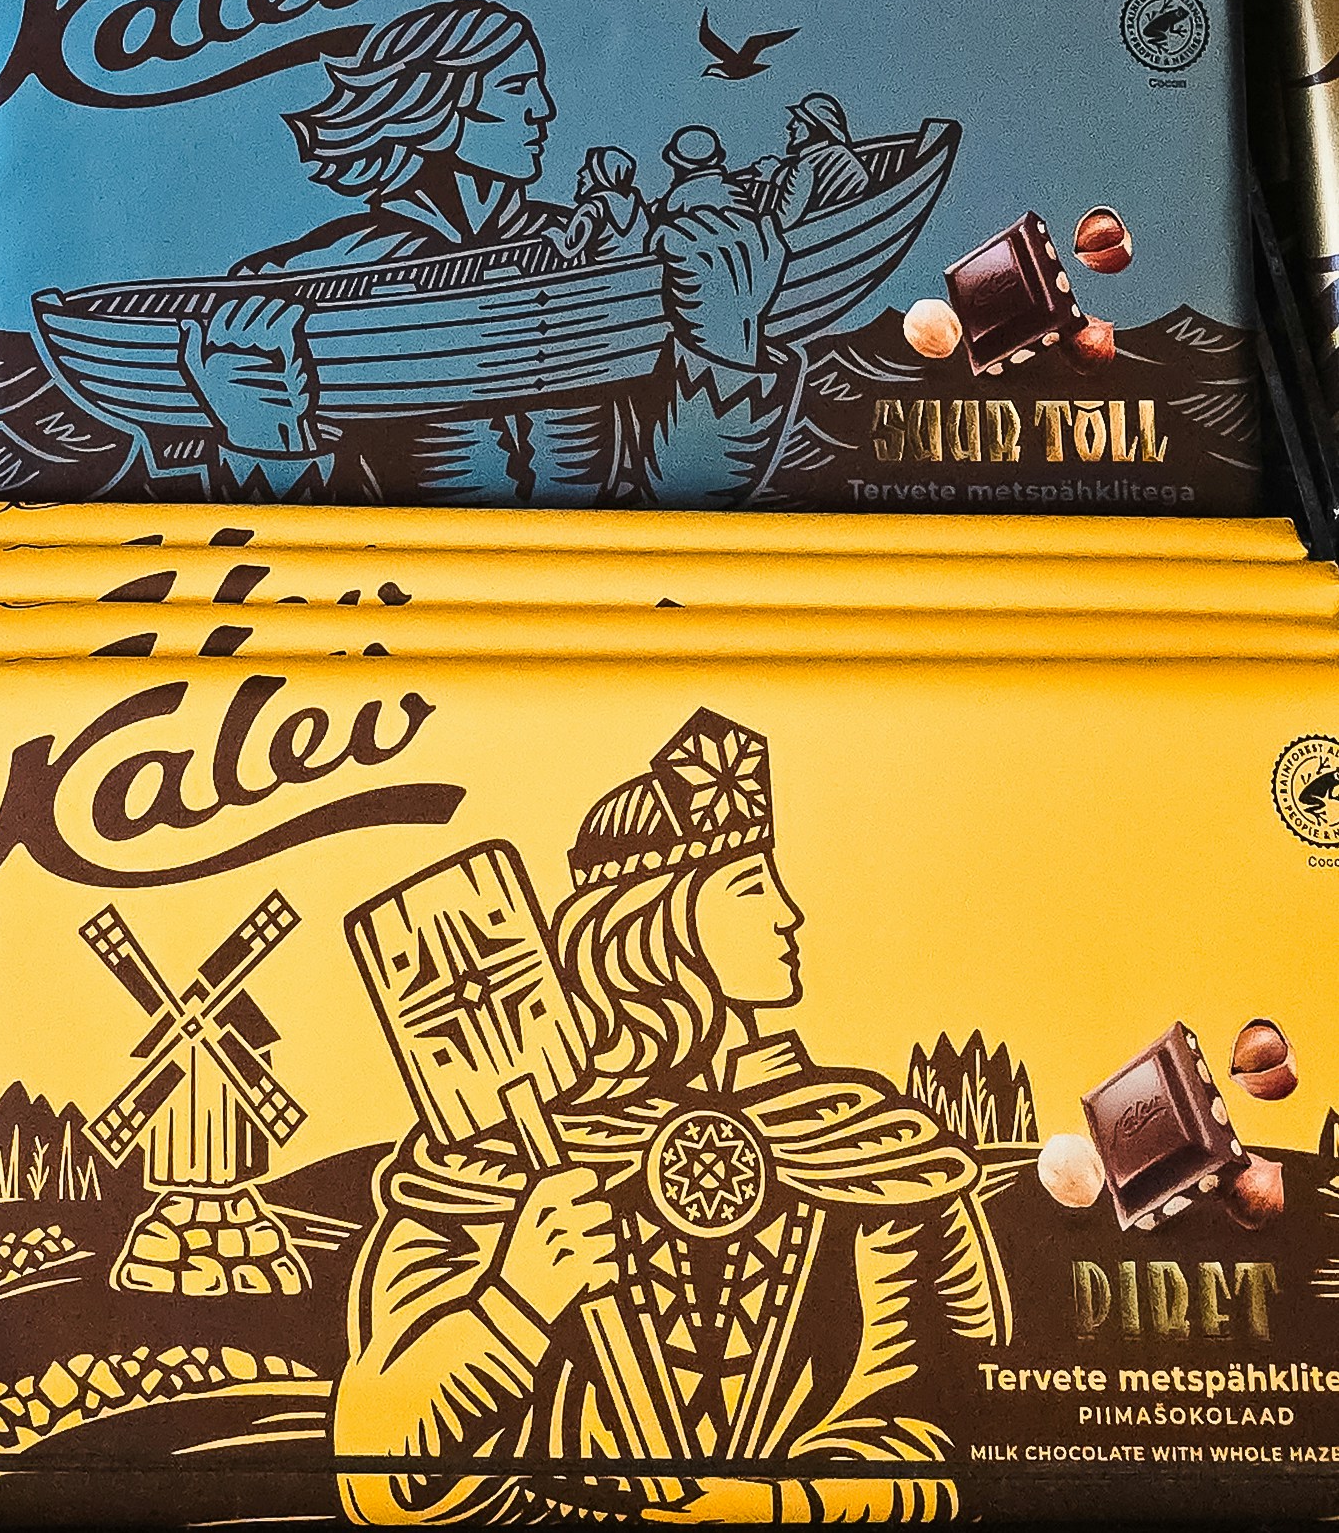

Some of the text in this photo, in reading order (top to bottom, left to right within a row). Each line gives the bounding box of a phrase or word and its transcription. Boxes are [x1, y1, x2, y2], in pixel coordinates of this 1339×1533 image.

[848, 479, 1195, 506] Tervete metspähklitega
[979, 1364, 1106, 1391] Tervete
[1079, 1404, 1294, 1425] PIIMAŠOKOLAAD
[971, 1446, 1019, 1462] MILK
[1025, 1446, 1145, 1462] CHOCOLATE
[1152, 1446, 1203, 1462] WITH
[1210, 1446, 1282, 1462] WHOLE
